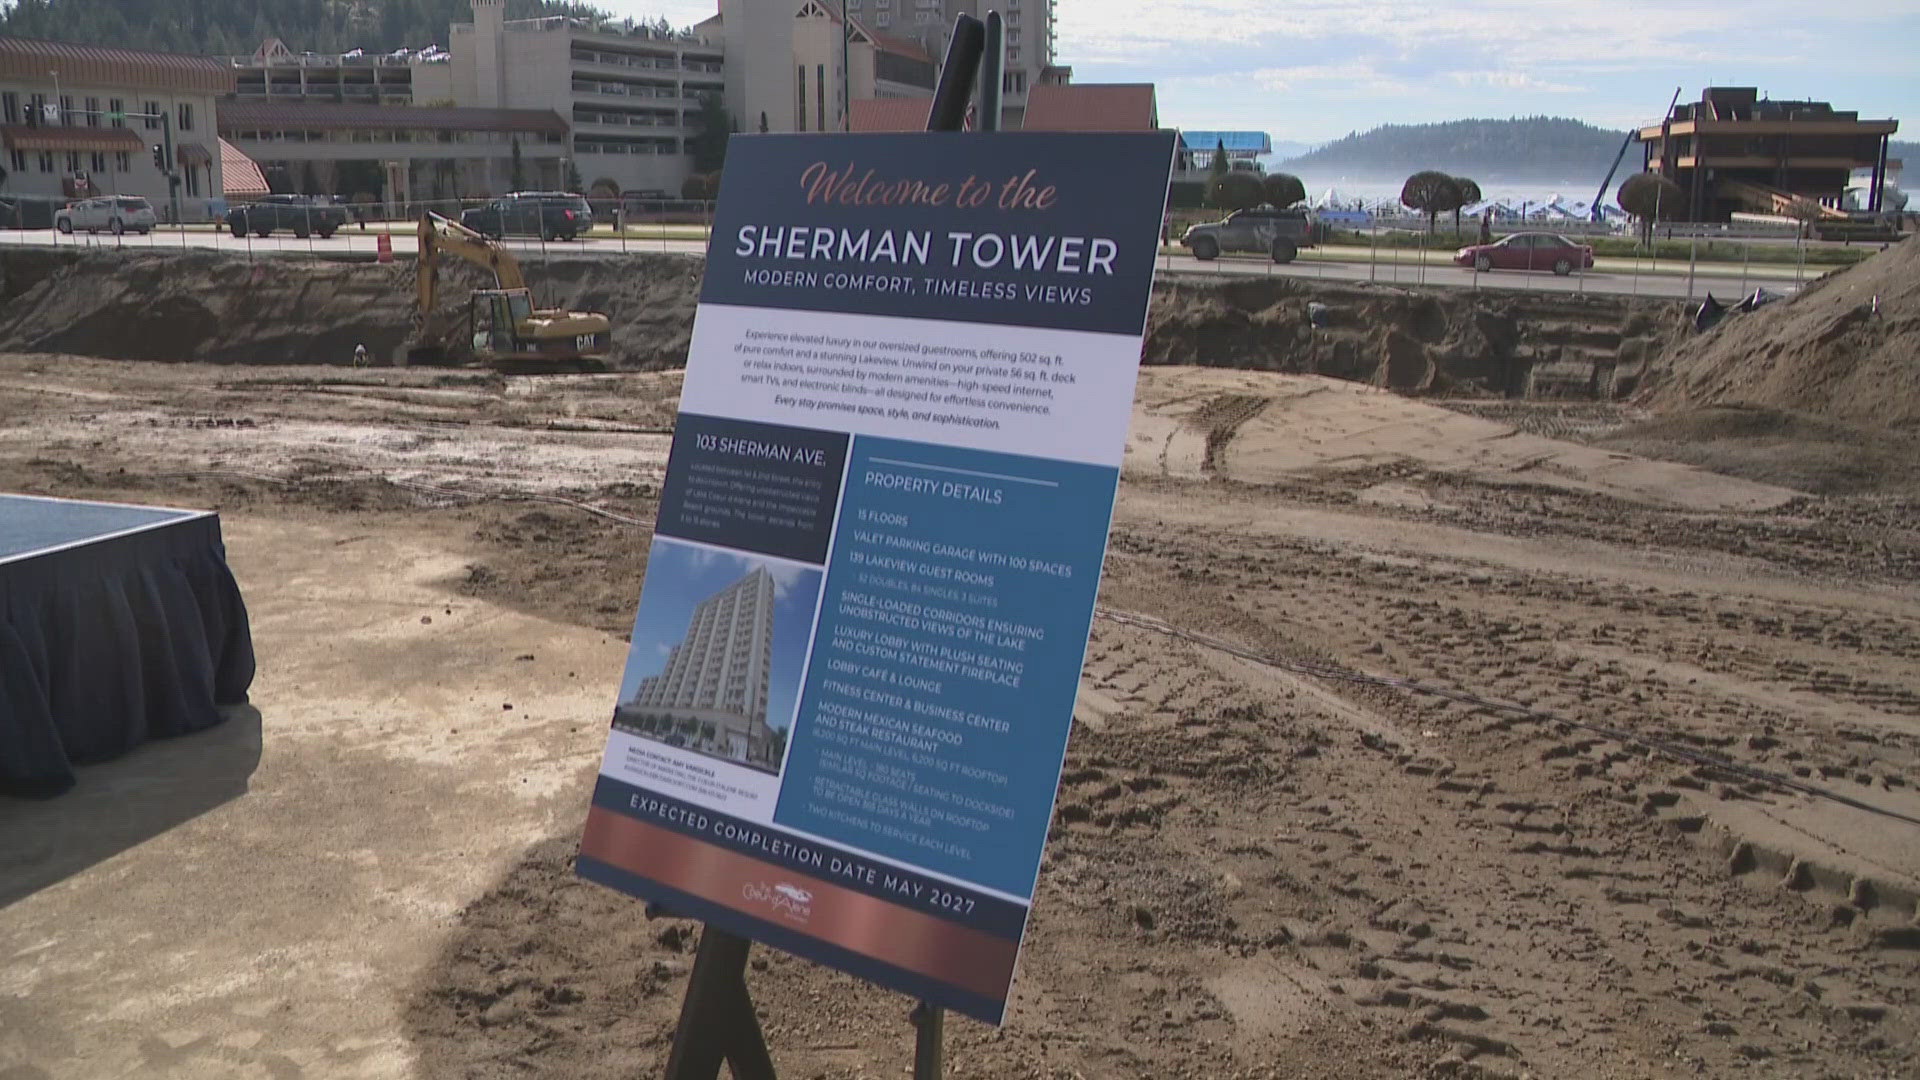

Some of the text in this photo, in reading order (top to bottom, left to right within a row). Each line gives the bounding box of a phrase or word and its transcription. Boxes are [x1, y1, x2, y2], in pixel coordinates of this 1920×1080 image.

[795, 160, 1062, 210] Welcome to the
[733, 224, 1121, 275] SHERMAN TOWER
[742, 267, 1093, 306] MODERN COMFORT, TIMELESS VIEWS
[576, 334, 595, 352] CAT
[733, 343, 742, 352] of
[742, 344, 762, 355] pure
[762, 345, 794, 357] comfort
[795, 348, 811, 359] and
[818, 350, 857, 364] stunning
[901, 358, 937, 370] Unwind
[938, 363, 951, 371] on
[951, 362, 974, 375] your
[974, 364, 1009, 378] private
[1009, 367, 1022, 378] 56
[1050, 371, 1077, 383] deck
[744, 328, 787, 343] Experience
[789, 332, 824, 345] elevated
[824, 335, 851, 349] luxury
[852, 337, 862, 348] in
[862, 340, 877, 349] our
[878, 340, 920, 353] oversized
[920, 343, 979, 360] guestrooms,
[979, 348, 1018, 363] offering
[1018, 351, 1037, 363] 502
[1053, 354, 1065, 365] ft.
[740, 372, 764, 384] smart
[781, 376, 798, 387] and
[798, 378, 840, 392] electronic
[885, 387, 928, 403] designed
[928, 391, 942, 402] for
[943, 393, 986, 407] effortless
[752, 359, 772, 369] relax
[805, 364, 855, 378] surrounded
[854, 369, 867, 381] by
[867, 370, 904, 382] modern
[1012, 384, 1055, 399] internet,
[773, 394, 797, 408] Every
[797, 397, 816, 410] stay
[816, 399, 856, 414] promises
[911, 409, 931, 421] and
[693, 432, 718, 451] 103
[717, 436, 792, 462] SHERMAN
[864, 470, 1004, 505] PROPERTY DETAILS
[857, 508, 909, 527] 15 FLOORS
[848, 551, 995, 587] 139 LAKEVIEW GUEST ROOMS
[852, 529, 1073, 578] VALET PARKING GARAGE WITH 100 SPACES
[838, 603, 1026, 651] UNOBSTRUCTED VIEWS OF THE LAKE
[840, 590, 1045, 641] SINGLE-LOADED CORRIDORS ENSURING
[830, 636, 1021, 688] AND CUSTOM STATEMENT FIREPLACE
[833, 624, 1025, 675] LUXURY LOBBY WITH PLUSH SEATING
[826, 658, 860, 676] LOBBY
[888, 671, 897, 684] &
[897, 674, 942, 694] LOUNGE
[816, 700, 963, 746] MODERN MEXICAN SEAFOOD
[822, 679, 1010, 734] FITNESS CENTER & BUSINESS CENTER
[814, 712, 939, 754] AND STEAK RESTAURANT
[629, 793, 977, 916] EXPECTED COMPLETION DATE MAY 2027
